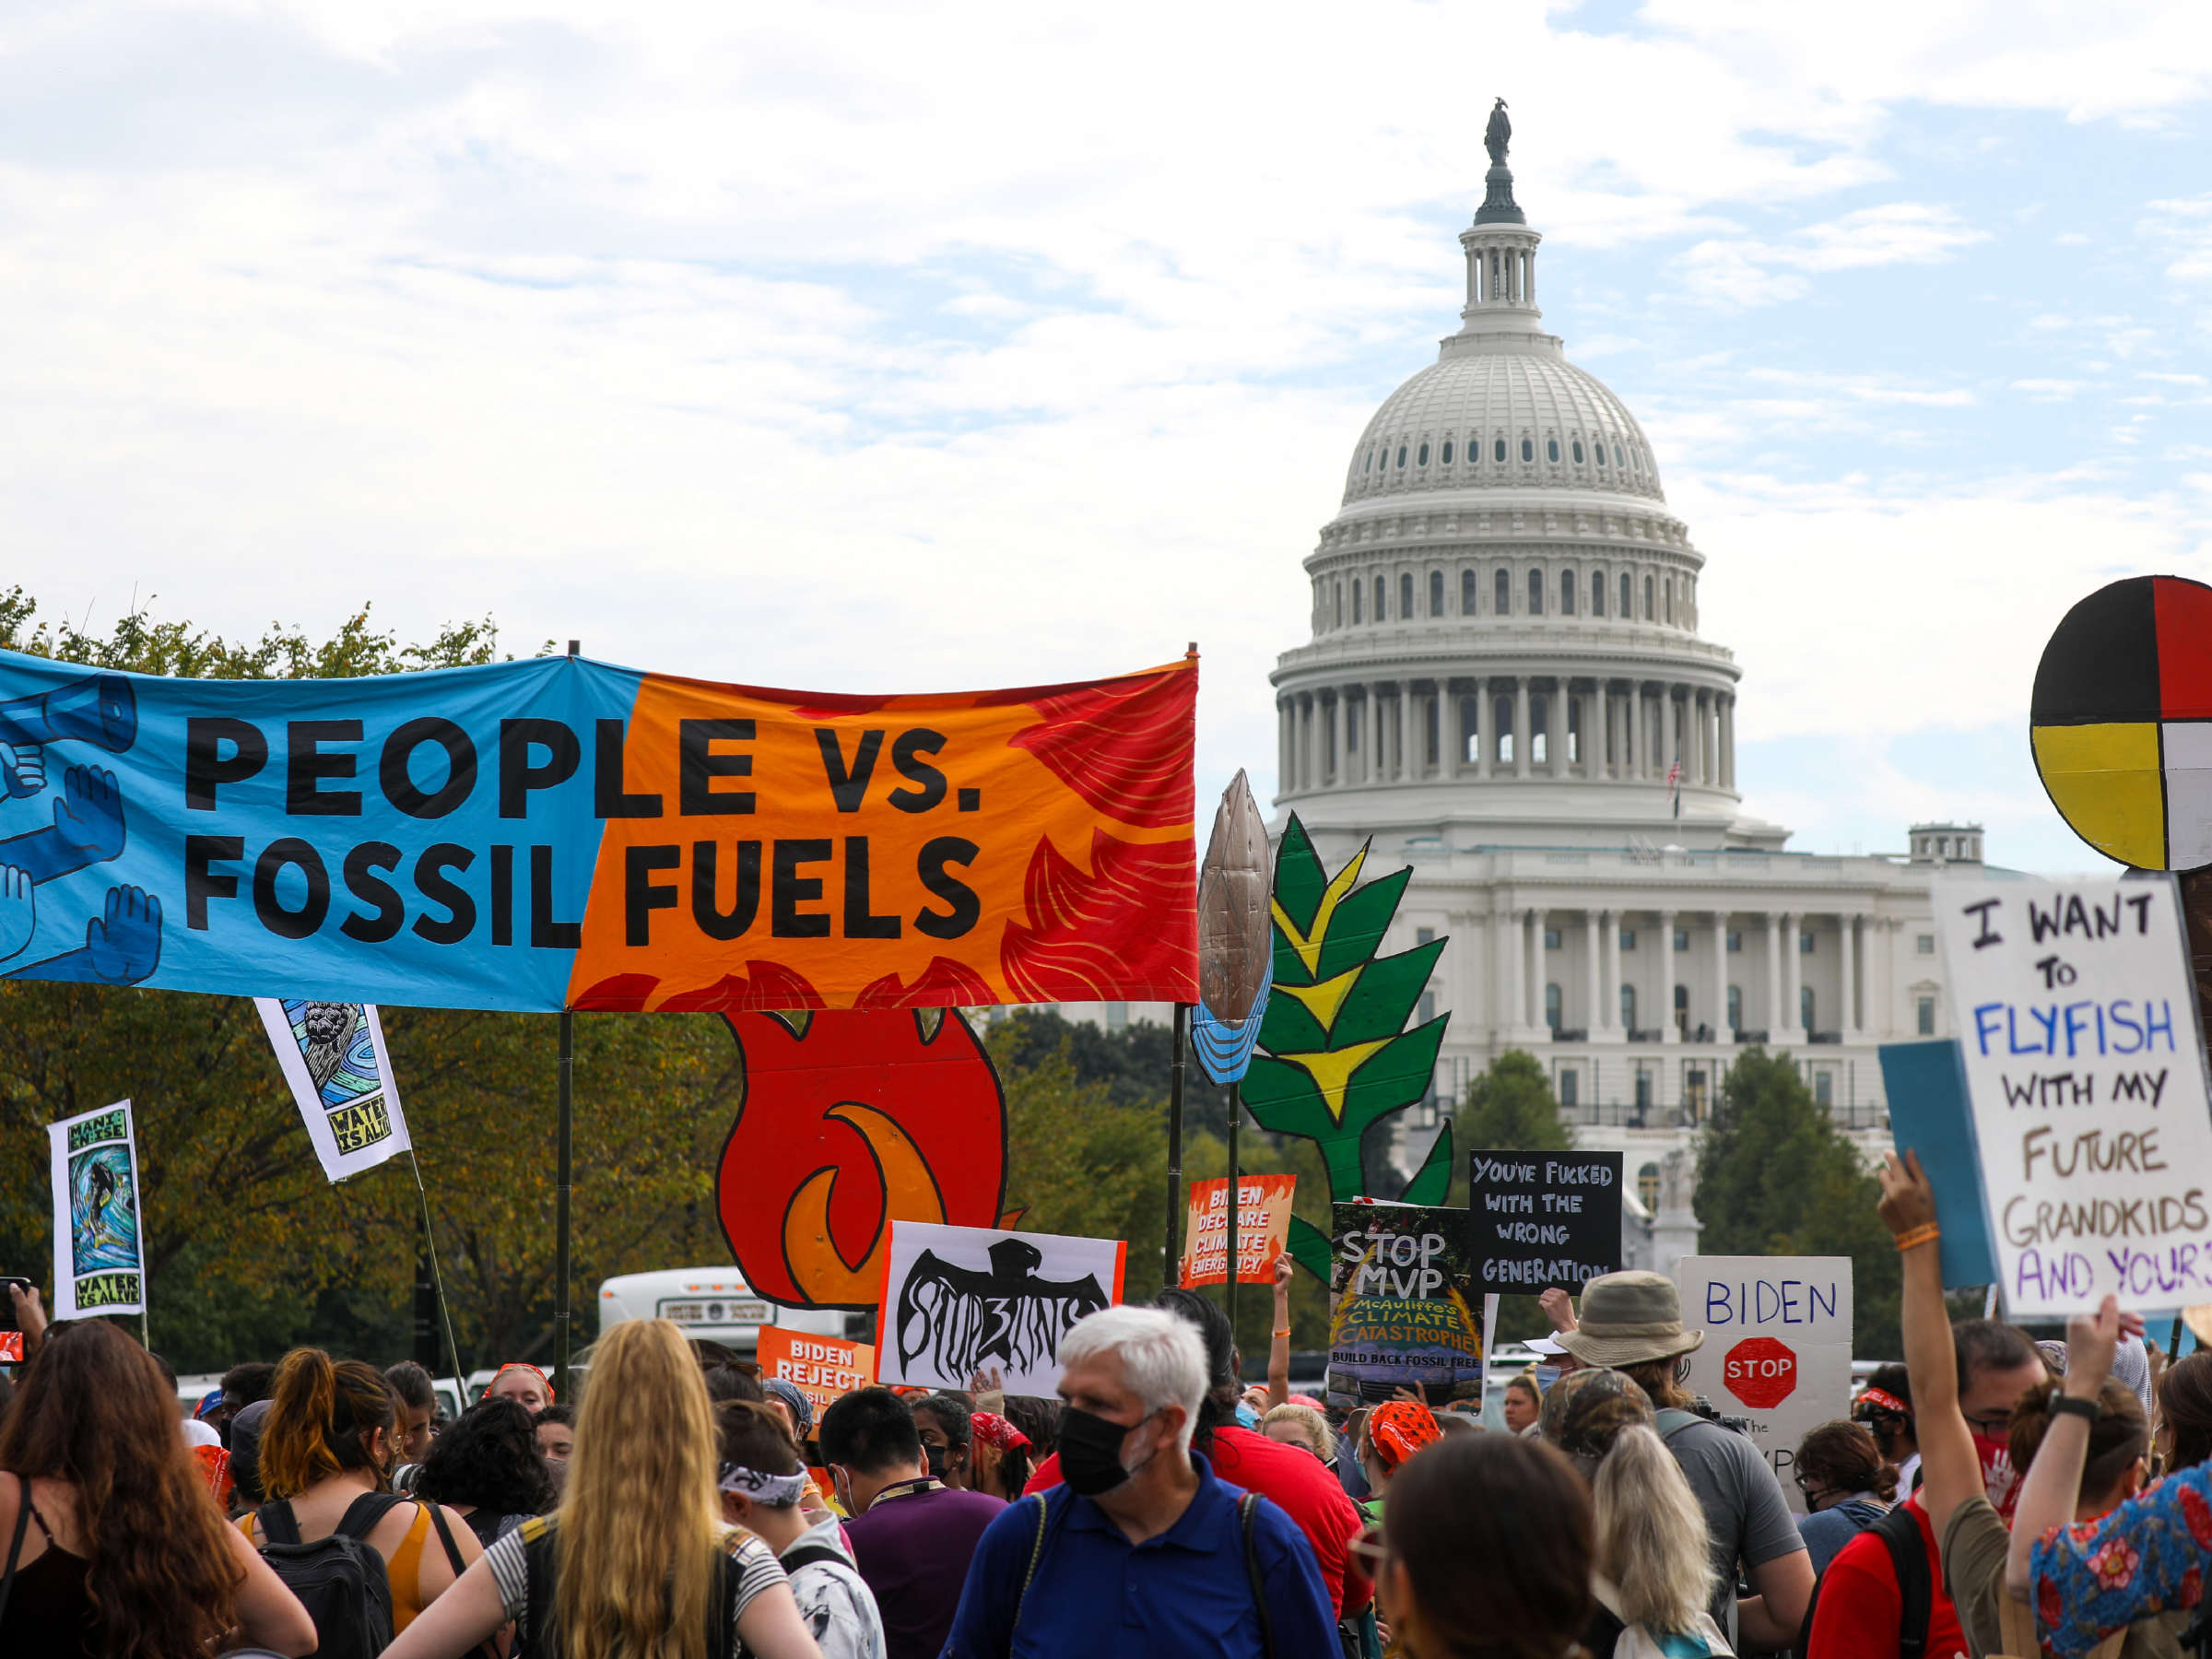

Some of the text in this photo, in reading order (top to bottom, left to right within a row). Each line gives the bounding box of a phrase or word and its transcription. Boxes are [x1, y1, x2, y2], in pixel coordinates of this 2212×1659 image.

[186, 716, 981, 820] PEOPLE VS.
[185, 835, 982, 949] FOSSIL FUELS
[1963, 891, 2154, 950] I WANT
[2035, 954, 2078, 991] TO
[1973, 998, 2176, 1058] FLYFISH
[2002, 1068, 2169, 1109] WITH MY
[338, 1130, 363, 1151] IS
[2022, 1124, 2169, 1182] FUTURE
[1545, 1161, 1613, 1187] FUCKED
[1209, 1185, 1264, 1209] BIEN
[1485, 1193, 1583, 1214] WITH THE
[1198, 1210, 1270, 1233] DECARE
[1496, 1221, 1571, 1245] WRONG
[2003, 1188, 2209, 1248] GRANDKIDS
[1195, 1233, 1266, 1255] CLIMTE
[1339, 1230, 1446, 1269] STOP
[1191, 1255, 1264, 1277] EMERGNCY
[2017, 1248, 2095, 1300] AND
[76, 1275, 138, 1294] WATER
[1356, 1264, 1443, 1300] MVP
[1706, 1280, 1836, 1324] BIDEN
[1347, 1311, 1461, 1330] CLIMATE
[791, 1339, 853, 1368] BIDEN
[1332, 1351, 1479, 1369] BUILD BACK FOSSIL FREE
[1726, 1359, 1793, 1378] STOP
[776, 1359, 865, 1393] REJECT
